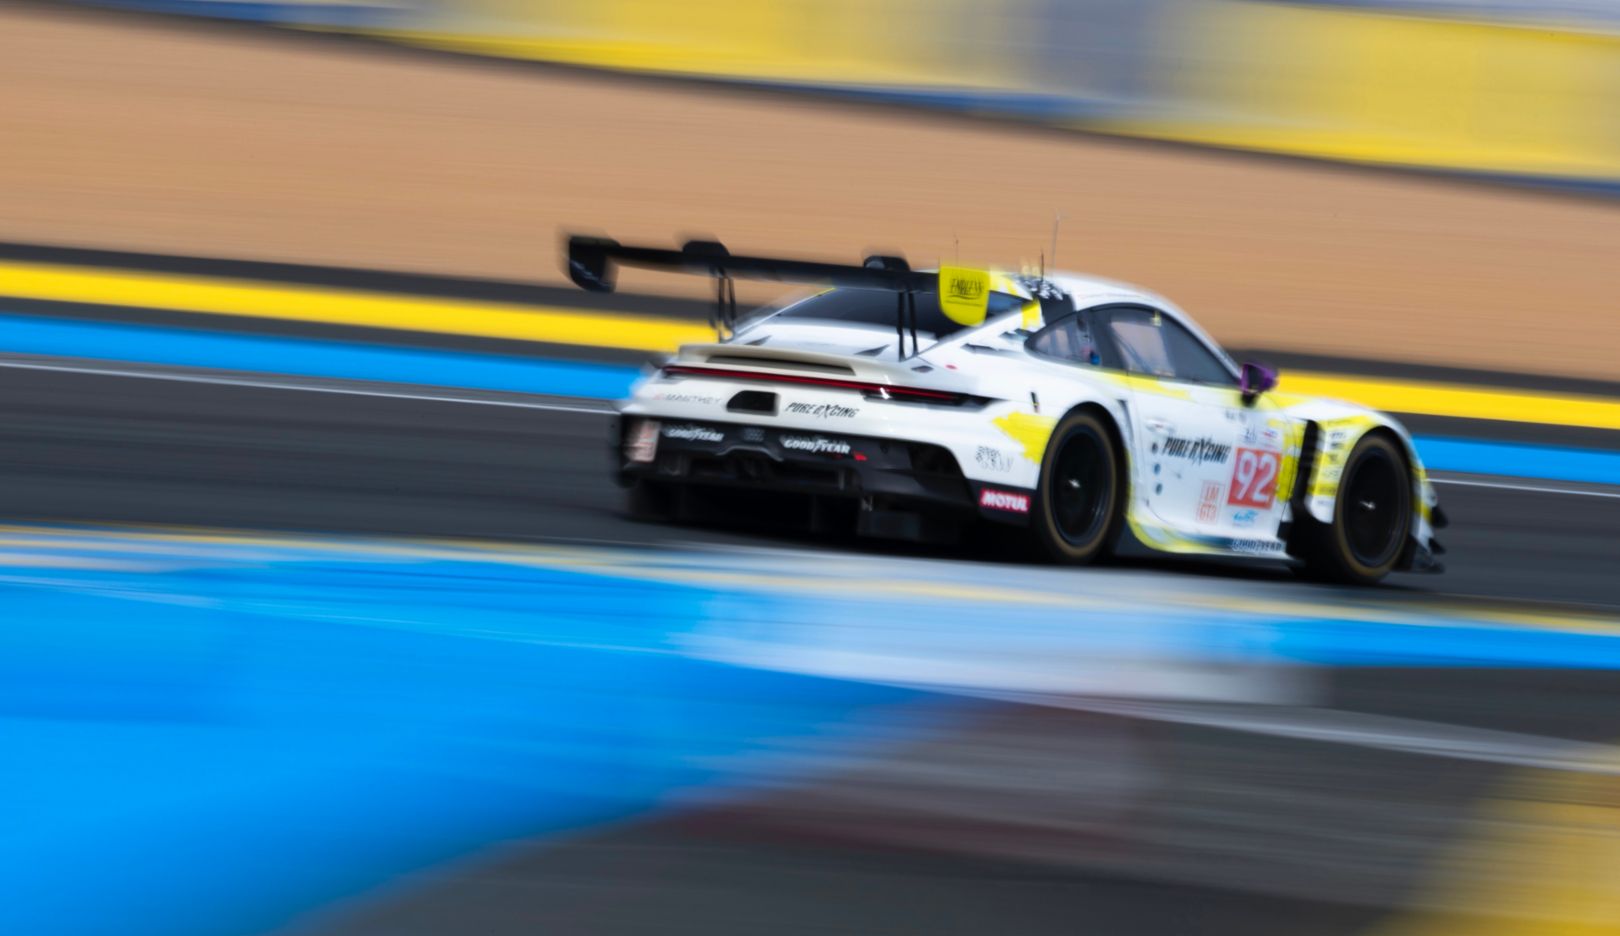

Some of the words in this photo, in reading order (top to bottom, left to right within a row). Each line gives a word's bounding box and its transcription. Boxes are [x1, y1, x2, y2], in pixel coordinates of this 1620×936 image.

[786, 402, 816, 414] PURE
[782, 438, 851, 455] GOODYEAR
[1162, 437, 1192, 458] PURE
[1236, 450, 1277, 502] 92
[981, 491, 1028, 512] MOTUL
